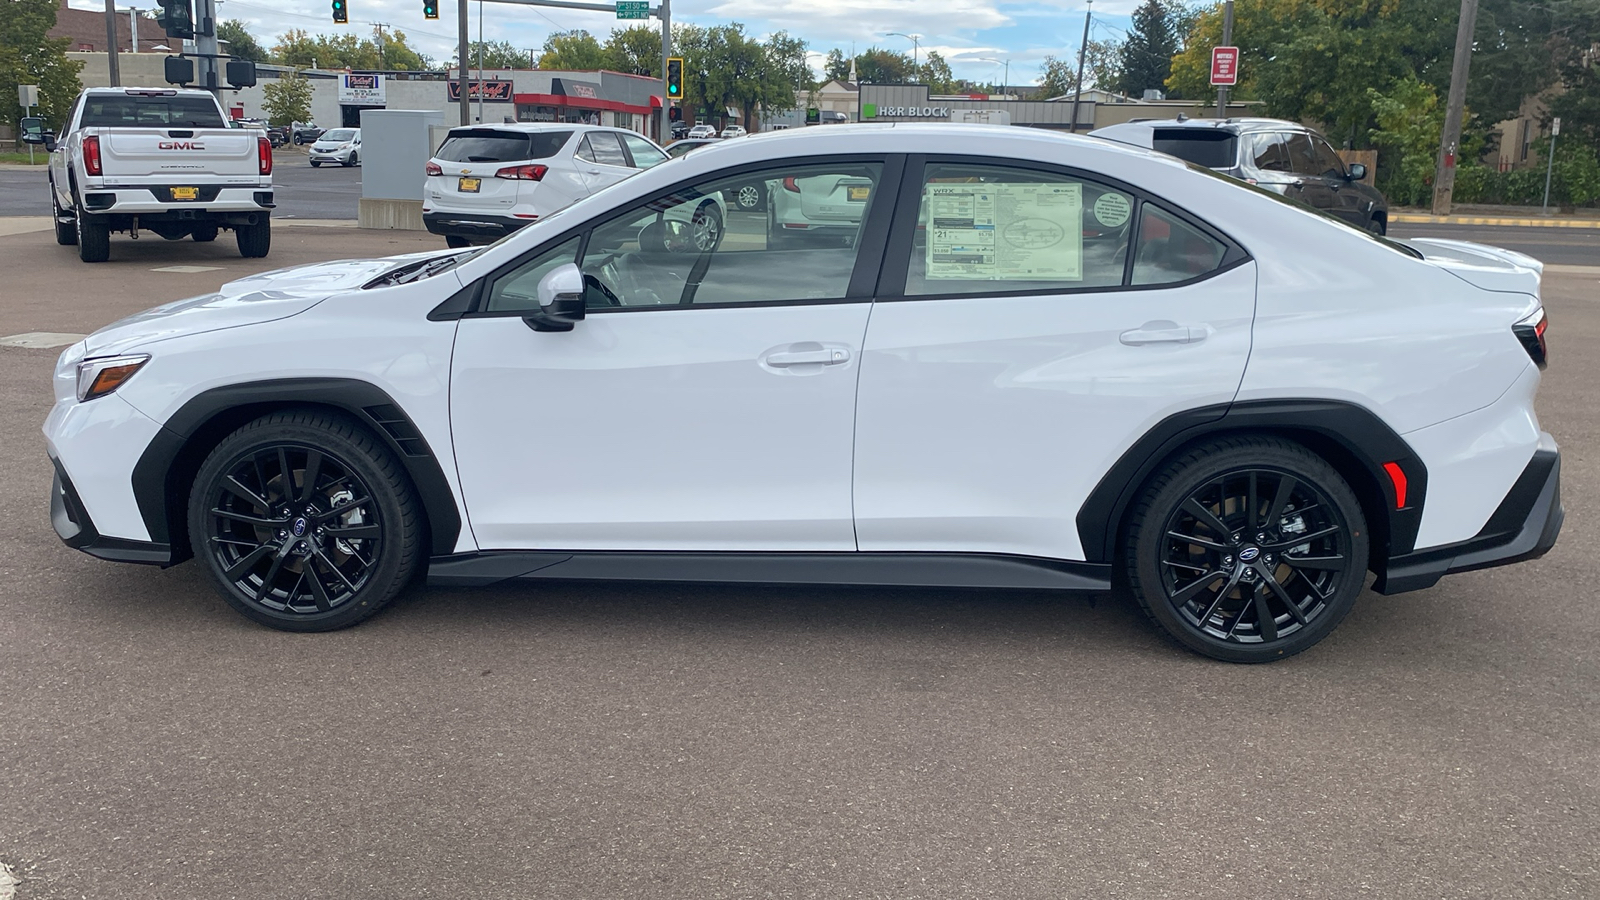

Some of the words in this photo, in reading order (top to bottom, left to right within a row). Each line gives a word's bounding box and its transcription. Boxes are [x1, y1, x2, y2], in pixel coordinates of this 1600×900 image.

[879, 106, 905, 116] H&R
[908, 107, 949, 117] BLOCK
[158, 142, 205, 150] GMC
